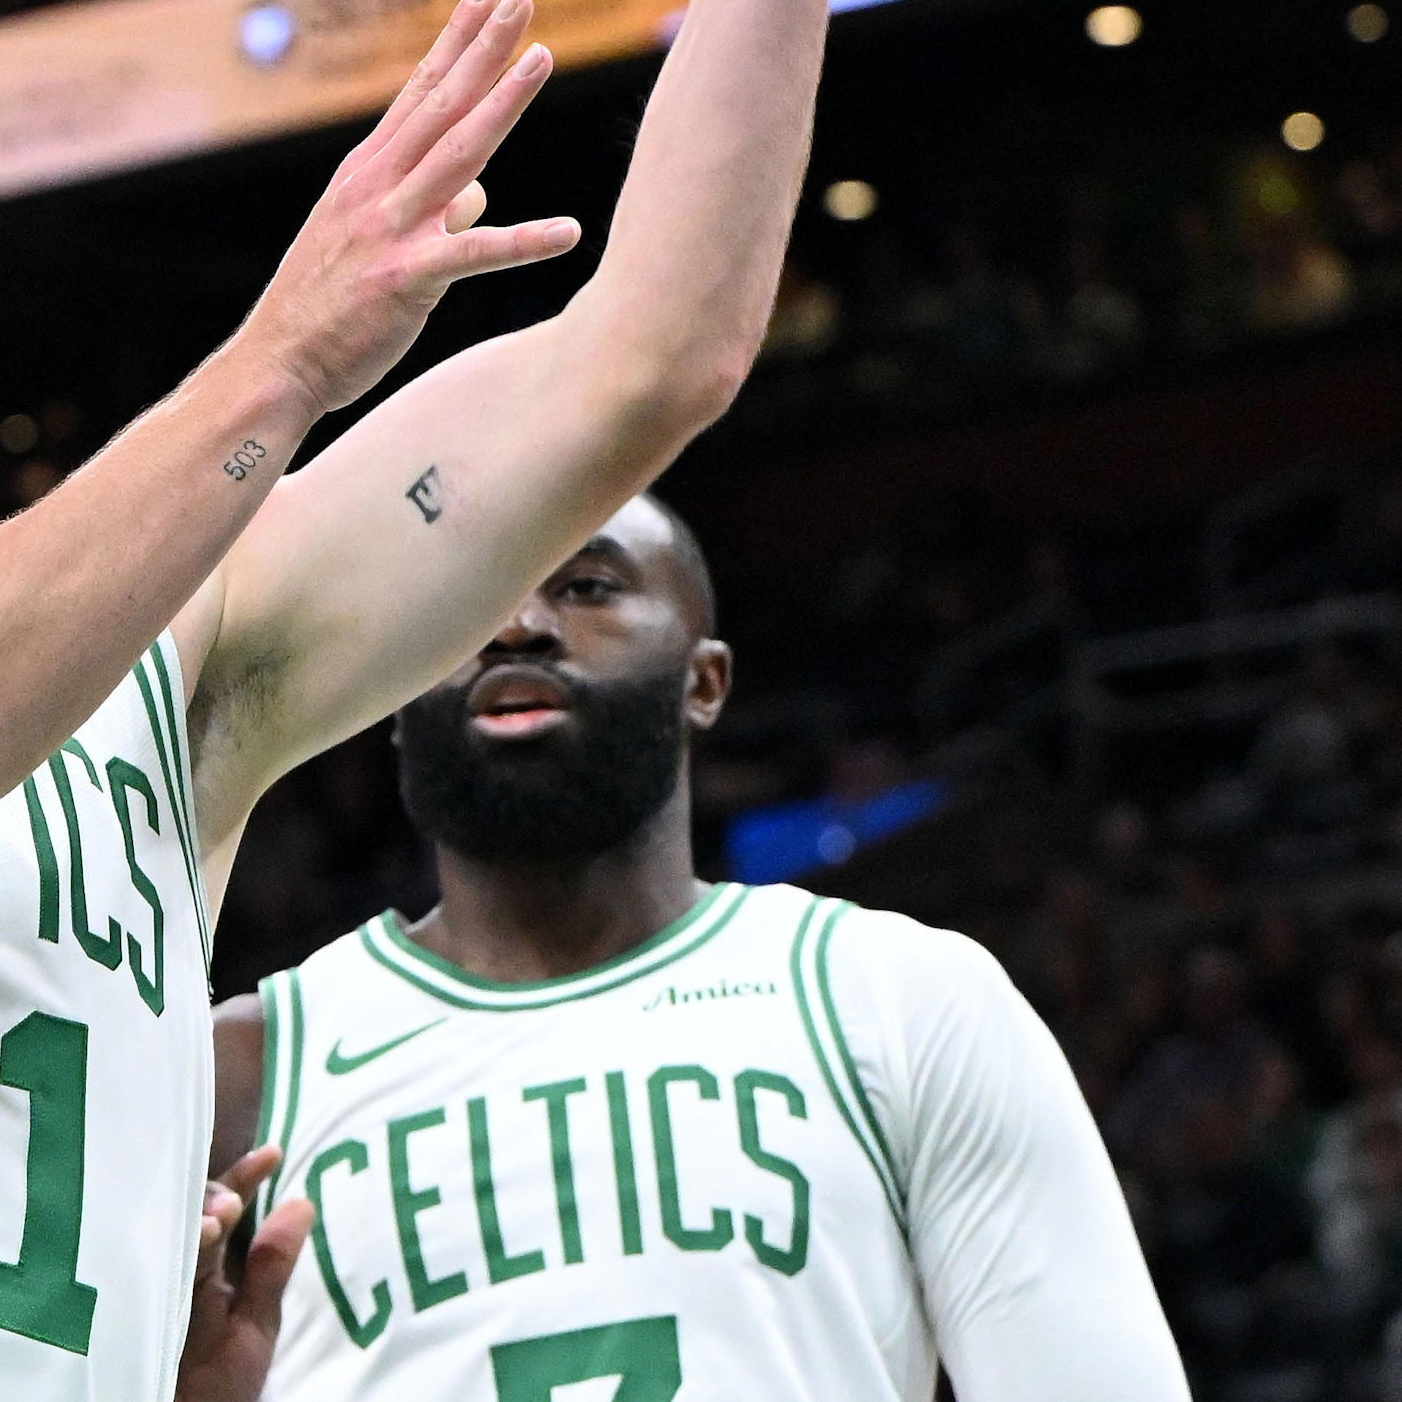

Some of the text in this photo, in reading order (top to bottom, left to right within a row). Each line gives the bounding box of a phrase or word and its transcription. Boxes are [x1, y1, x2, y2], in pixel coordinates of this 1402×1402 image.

[223, 439, 267, 482] 503
[642, 979, 777, 1011] Amica
[305, 1064, 809, 1350] CELTICS
